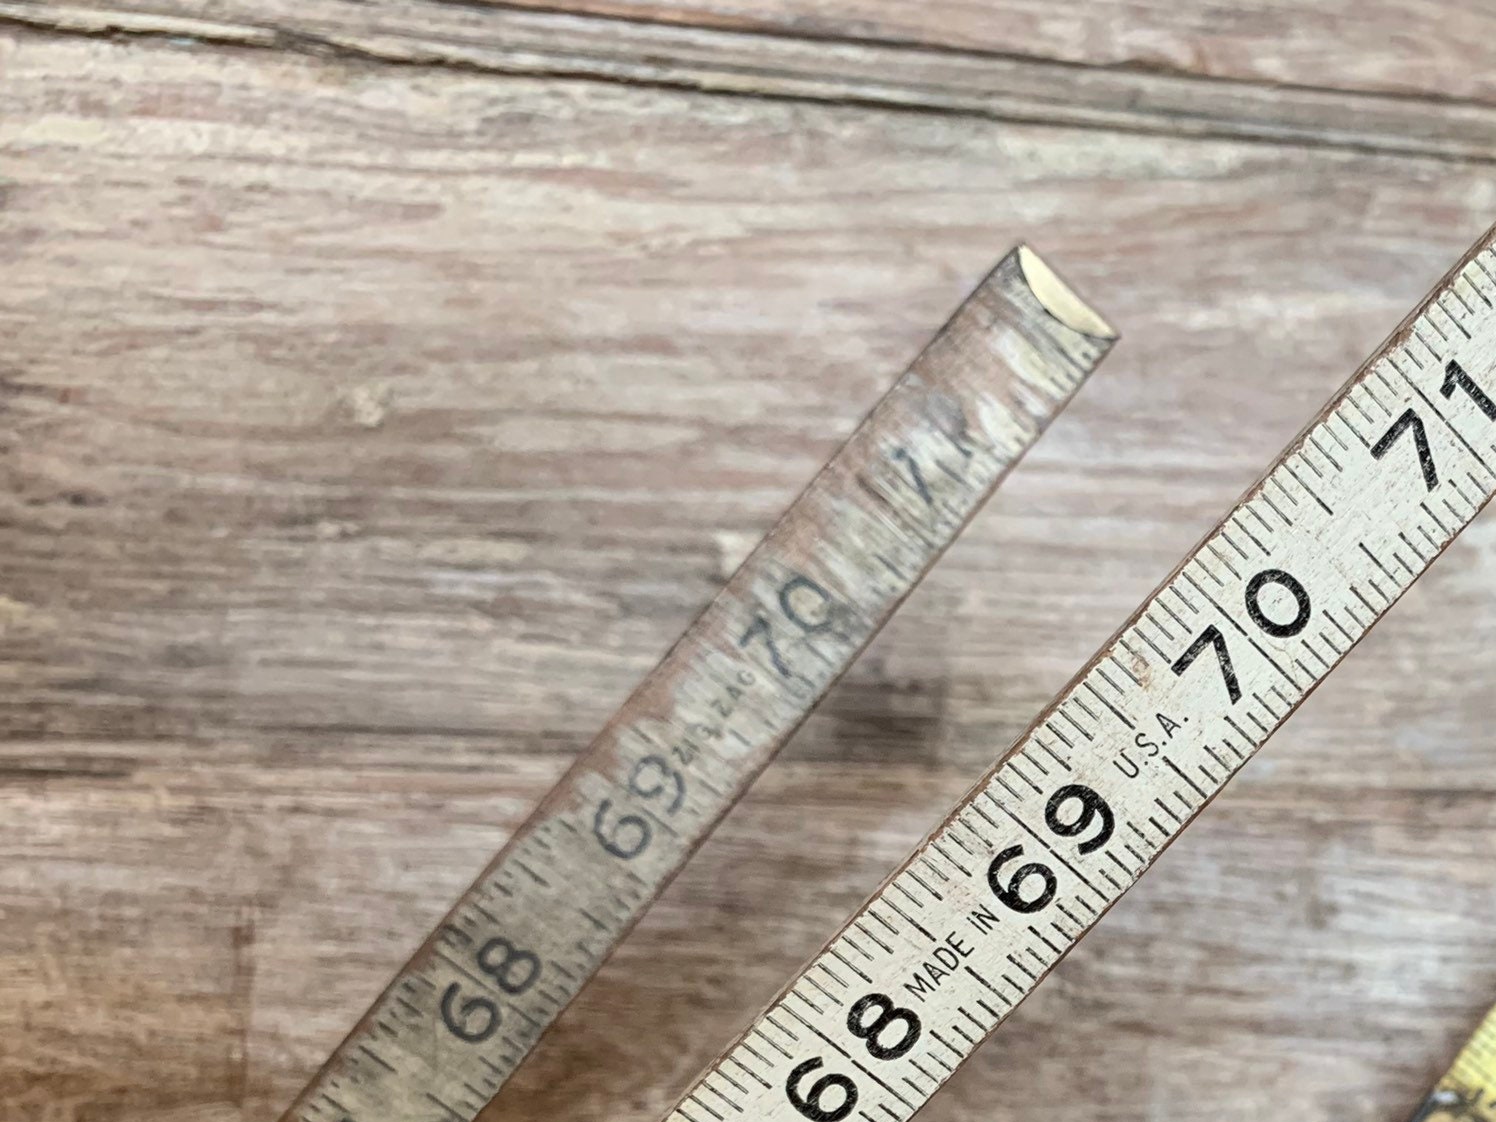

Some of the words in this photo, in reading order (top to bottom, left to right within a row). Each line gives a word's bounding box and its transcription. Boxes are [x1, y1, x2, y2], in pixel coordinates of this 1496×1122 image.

[441, 935, 541, 1044] 68
[594, 752, 686, 862] 69
[739, 573, 834, 679] 70
[903, 933, 976, 1003] MADE
[971, 904, 1001, 937] IN
[986, 783, 1116, 914] 69
[1113, 712, 1190, 780] U.S.A.
[1170, 567, 1312, 705] 70
